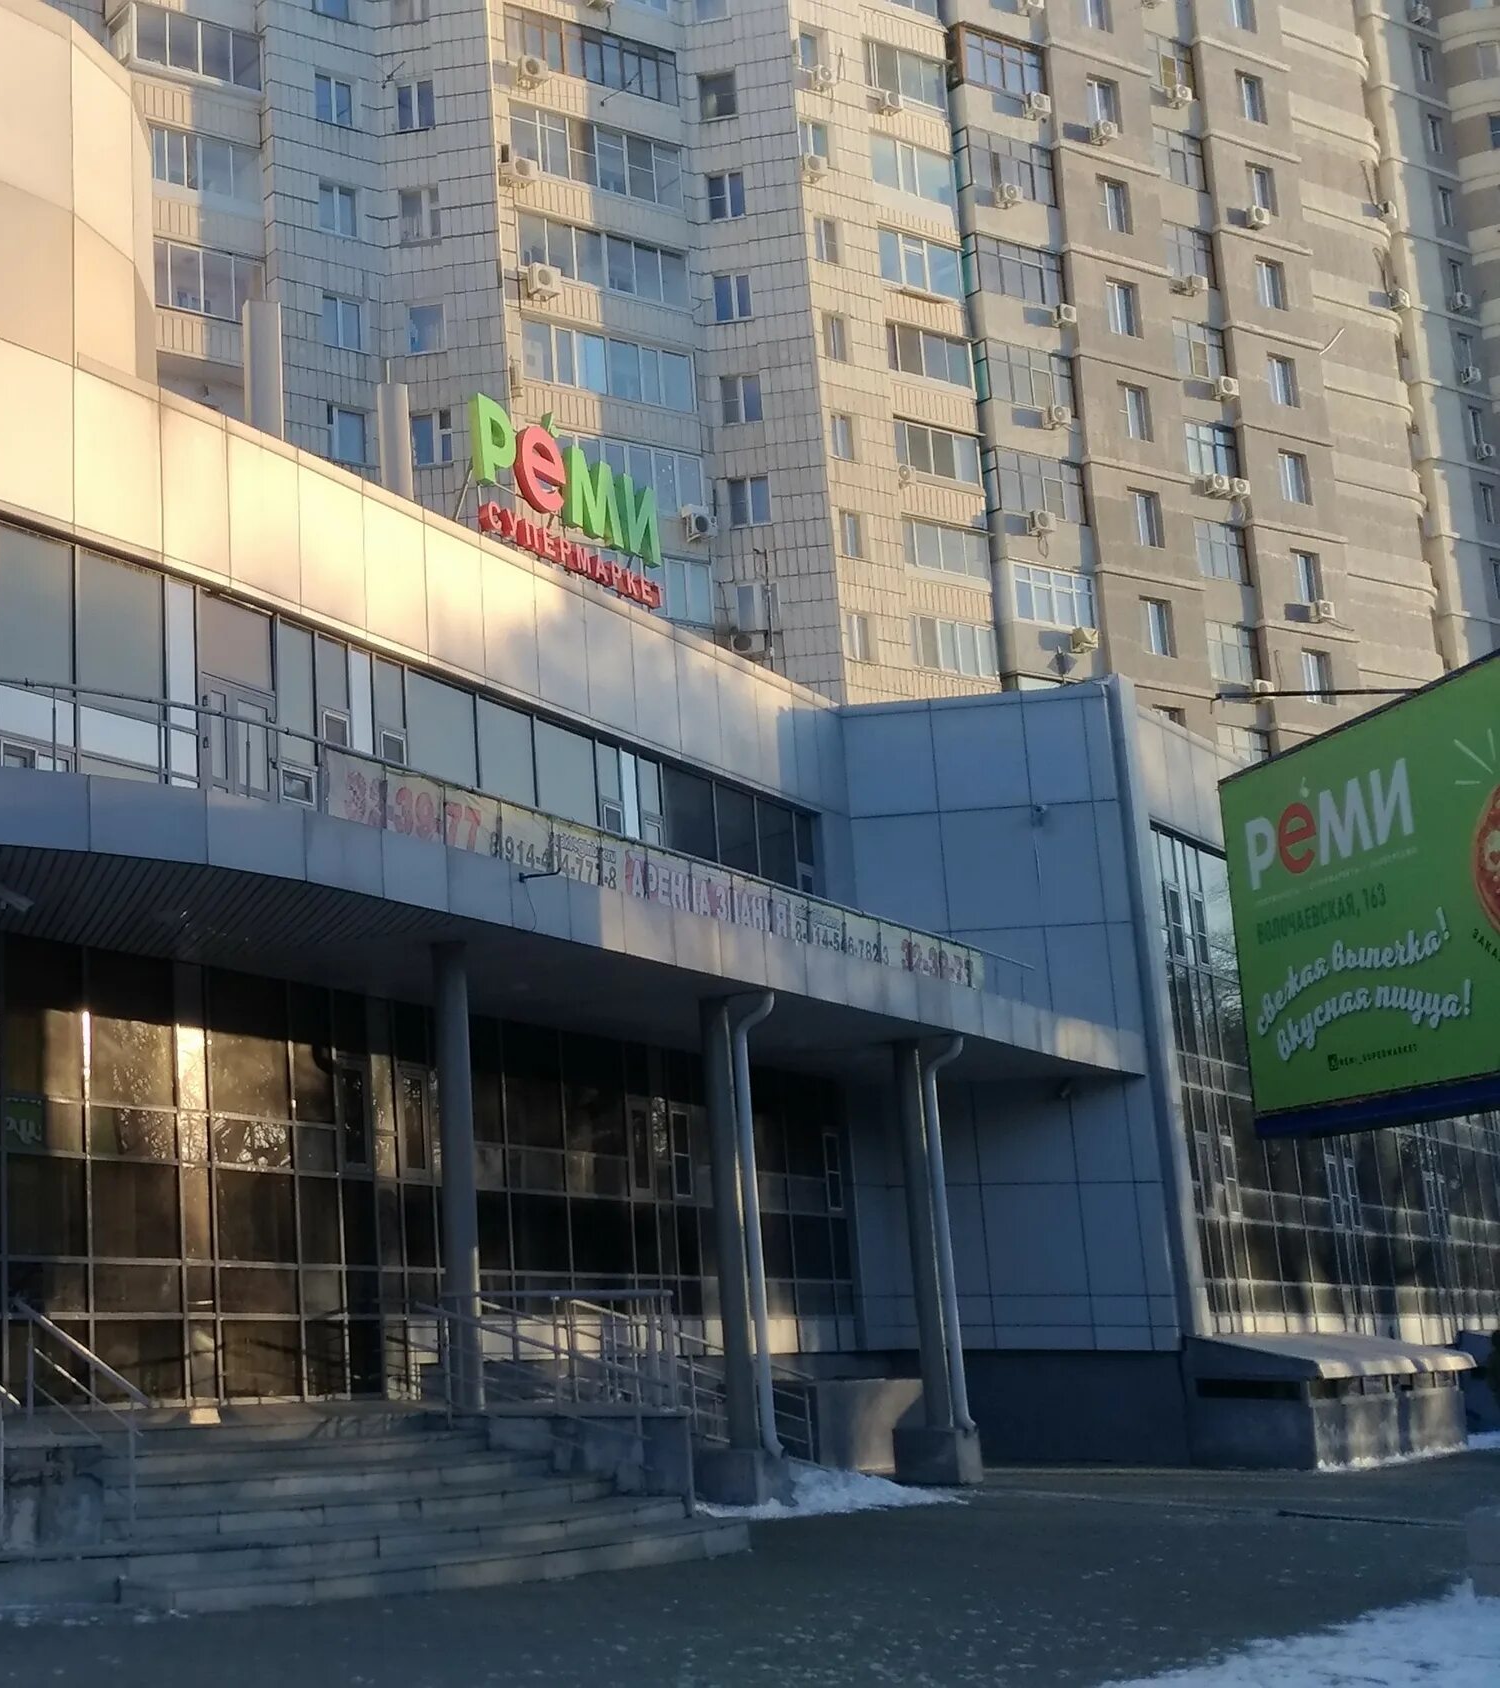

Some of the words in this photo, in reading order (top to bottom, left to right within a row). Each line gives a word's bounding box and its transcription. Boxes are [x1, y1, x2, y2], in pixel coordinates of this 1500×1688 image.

[1363, 882, 1387, 909] 163
[1257, 957, 1329, 1036] свежая
[1331, 906, 1450, 972] выпечка!
[1471, 928, 1500, 963] ЗАКА
[1277, 986, 1372, 1062] вкусная
[1375, 979, 1472, 1029] пицца!
